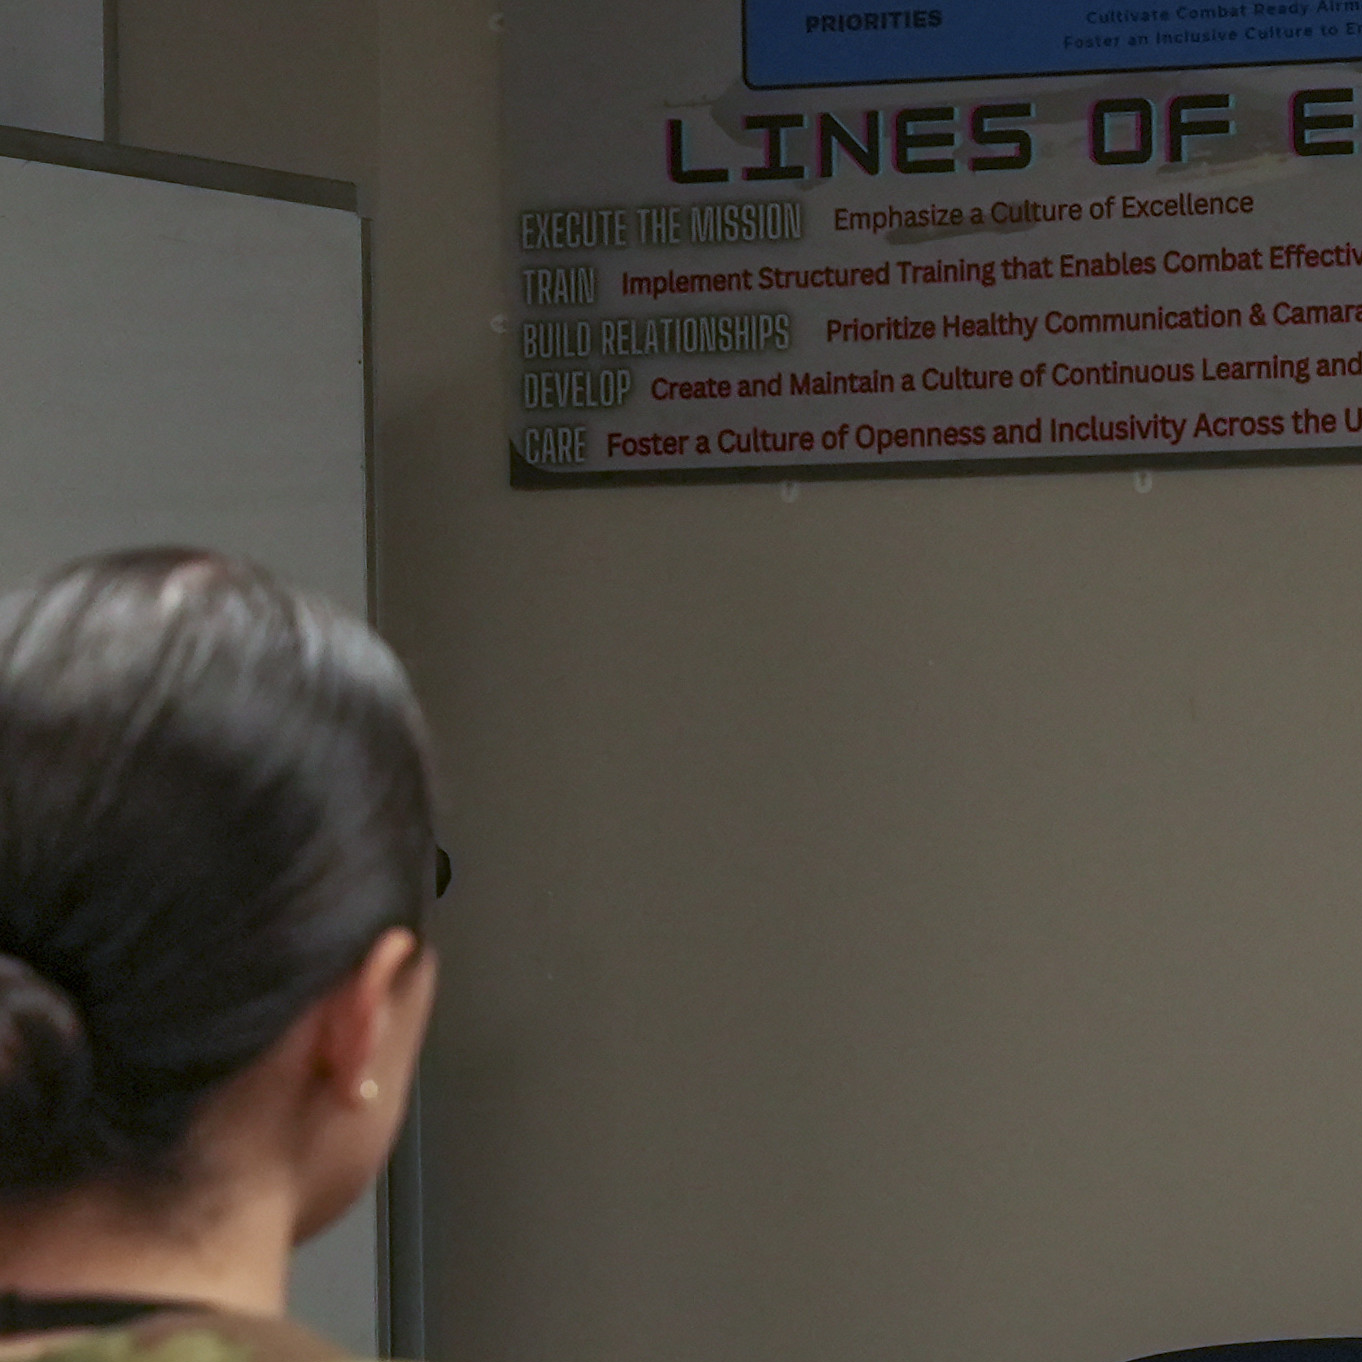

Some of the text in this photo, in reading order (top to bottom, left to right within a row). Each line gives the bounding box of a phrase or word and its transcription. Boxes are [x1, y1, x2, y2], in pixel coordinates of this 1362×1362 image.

[805, 10, 943, 34] PRIORITIES
[1086, 9, 1169, 24] Cultivate
[1176, 5, 1247, 20] Combat
[1254, 2, 1308, 17] Ready
[1064, 35, 1119, 50] Foster
[1127, 35, 1148, 47] an
[1156, 30, 1238, 45] Inclusive
[1244, 26, 1313, 41] Culture
[1320, 24, 1338, 36] to
[667, 103, 1037, 185] LINES
[1089, 94, 1236, 167] OF
[521, 203, 801, 250] EXECUTE THE MISSION
[835, 193, 1253, 234] Emphasize a Culture of Excellence
[523, 266, 595, 305] TRAIN
[623, 270, 752, 299] Implement
[759, 262, 889, 290] Structured
[896, 259, 996, 287] Training
[1001, 256, 1053, 280] that
[1061, 252, 1156, 278] Enables
[1163, 248, 1263, 274] Combat
[523, 314, 790, 359] BUILD RELATIONSHIPS
[827, 316, 936, 342] Prioritize
[943, 312, 1038, 342] Healthy
[1045, 304, 1241, 334] Communication
[1249, 303, 1266, 326] &
[523, 369, 632, 409] DEVELOP
[652, 378, 731, 400] Create
[737, 373, 782, 397] and
[790, 370, 894, 395] Maintain
[901, 374, 915, 391] a
[922, 366, 1013, 391] Culture
[1020, 363, 1046, 387] of
[1052, 361, 1194, 386] Continuous
[1203, 355, 1310, 384] Learning
[1316, 351, 1362, 376] and
[525, 426, 587, 465] CARE
[608, 433, 689, 457] Foster
[696, 435, 711, 454] a
[718, 427, 814, 453] Culture
[822, 424, 849, 450] of
[855, 424, 986, 454] Openness
[993, 418, 1041, 444] and
[1051, 414, 1186, 445] Inclusivity
[1193, 413, 1284, 438] Across
[1291, 408, 1336, 434] the
